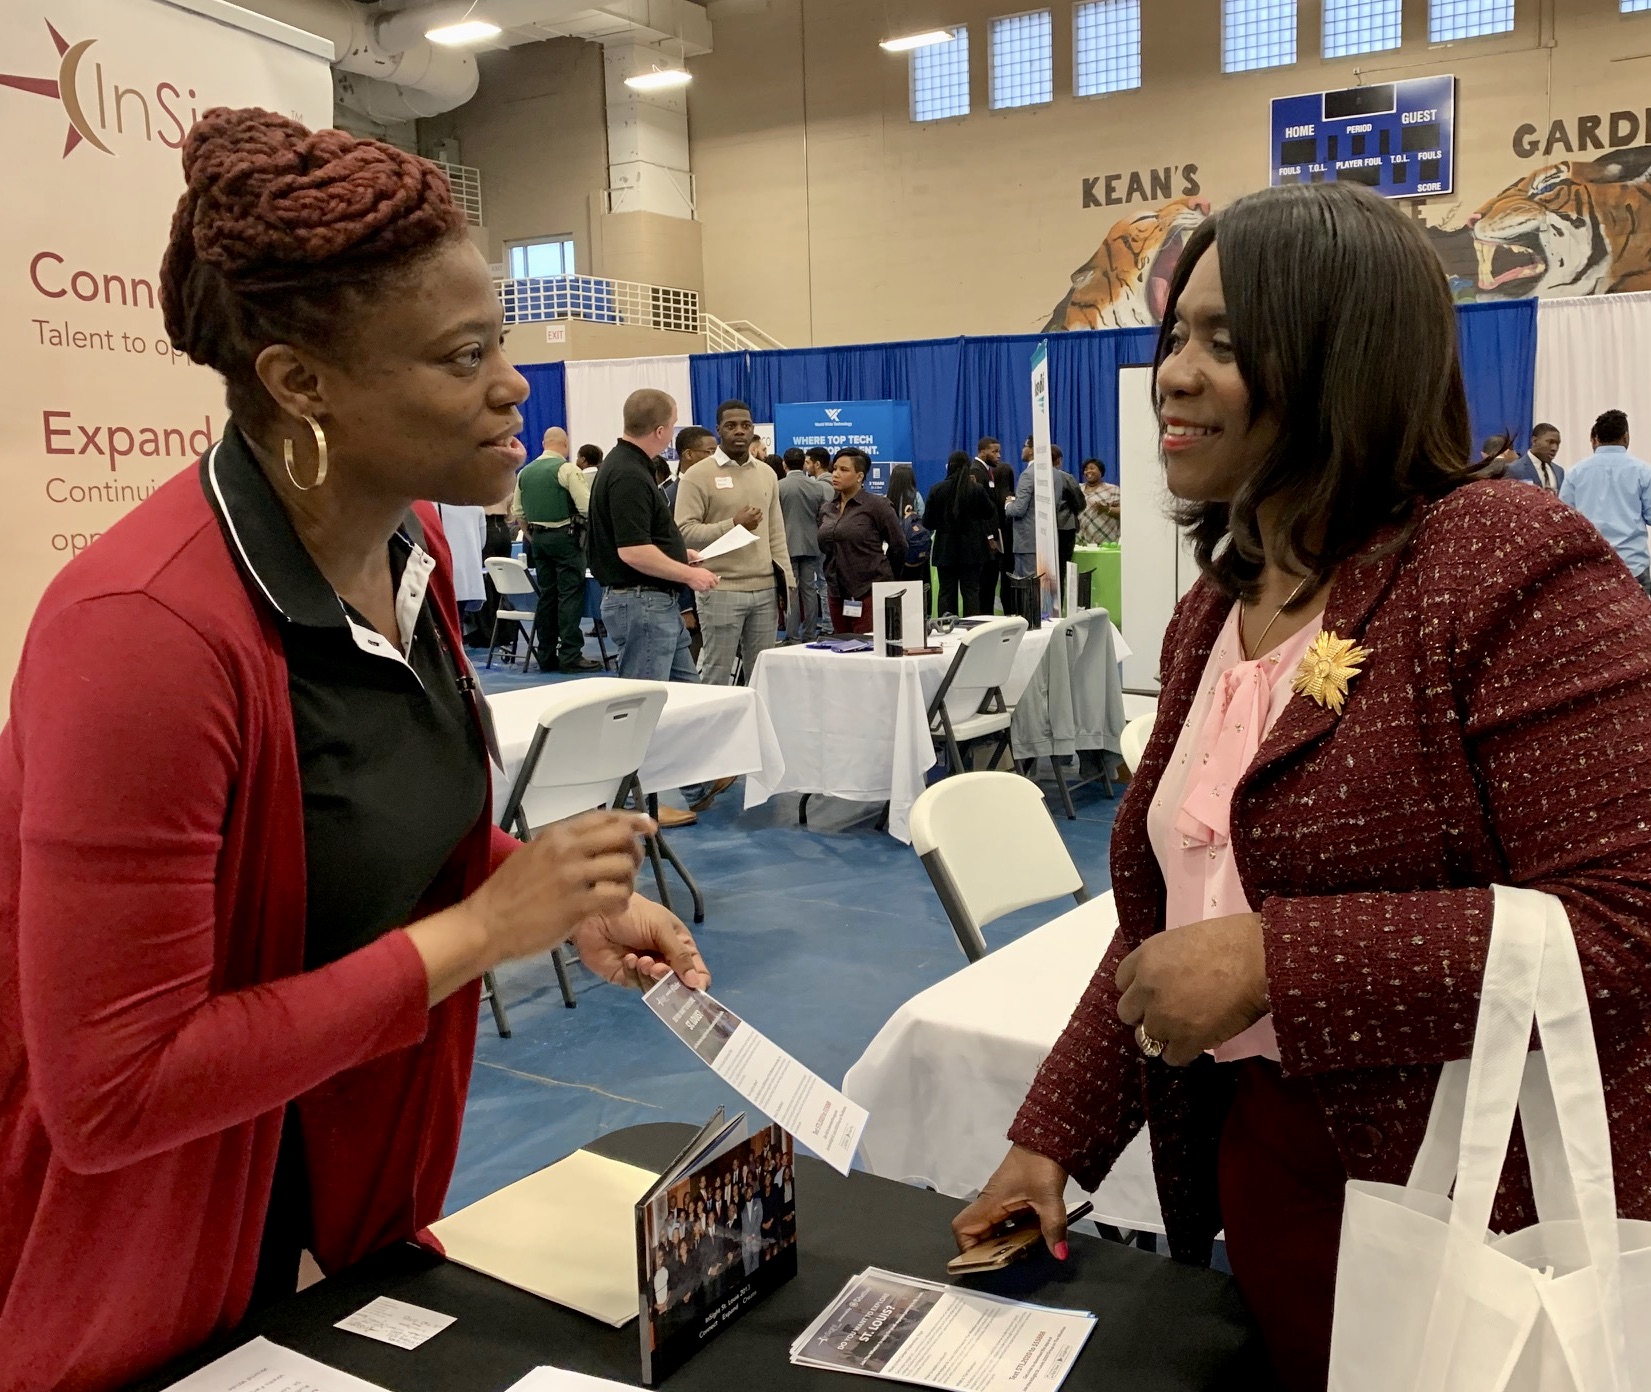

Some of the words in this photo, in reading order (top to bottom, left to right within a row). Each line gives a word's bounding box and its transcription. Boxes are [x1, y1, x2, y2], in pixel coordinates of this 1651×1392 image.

[95, 62, 198, 149] InSi
[1401, 109, 1438, 124] GUEST
[1285, 124, 1315, 139] HOME
[1346, 123, 1373, 134] PERIOD
[1512, 107, 1651, 159] GARD
[1336, 159, 1363, 170] PLAYER
[1364, 156, 1383, 167] FOUL
[1390, 154, 1411, 164] T.O.L.
[1417, 150, 1443, 161] FOULS
[1278, 165, 1302, 176] FOULS
[1308, 162, 1328, 172] T.O.L.
[1082, 163, 1201, 209] KEAN'S
[1416, 182, 1442, 192] SCORE
[29, 251, 163, 309] Conn
[31, 319, 115, 352] Talent
[121, 331, 147, 354] to
[547, 330, 564, 340] EXIT
[42, 410, 214, 472] Expand
[793, 436, 826, 445] WHERE
[827, 435, 847, 445] TOP
[848, 434, 874, 445] TECH
[837, 1340, 848, 1350] DO
[846, 1330, 857, 1341] YOU
[854, 1318, 867, 1332] WANT
[865, 1310, 874, 1319] TO
[871, 1293, 891, 1311] EXPLORE
[859, 1331, 875, 1343] ST.
[868, 1304, 896, 1331] LOUIS?
